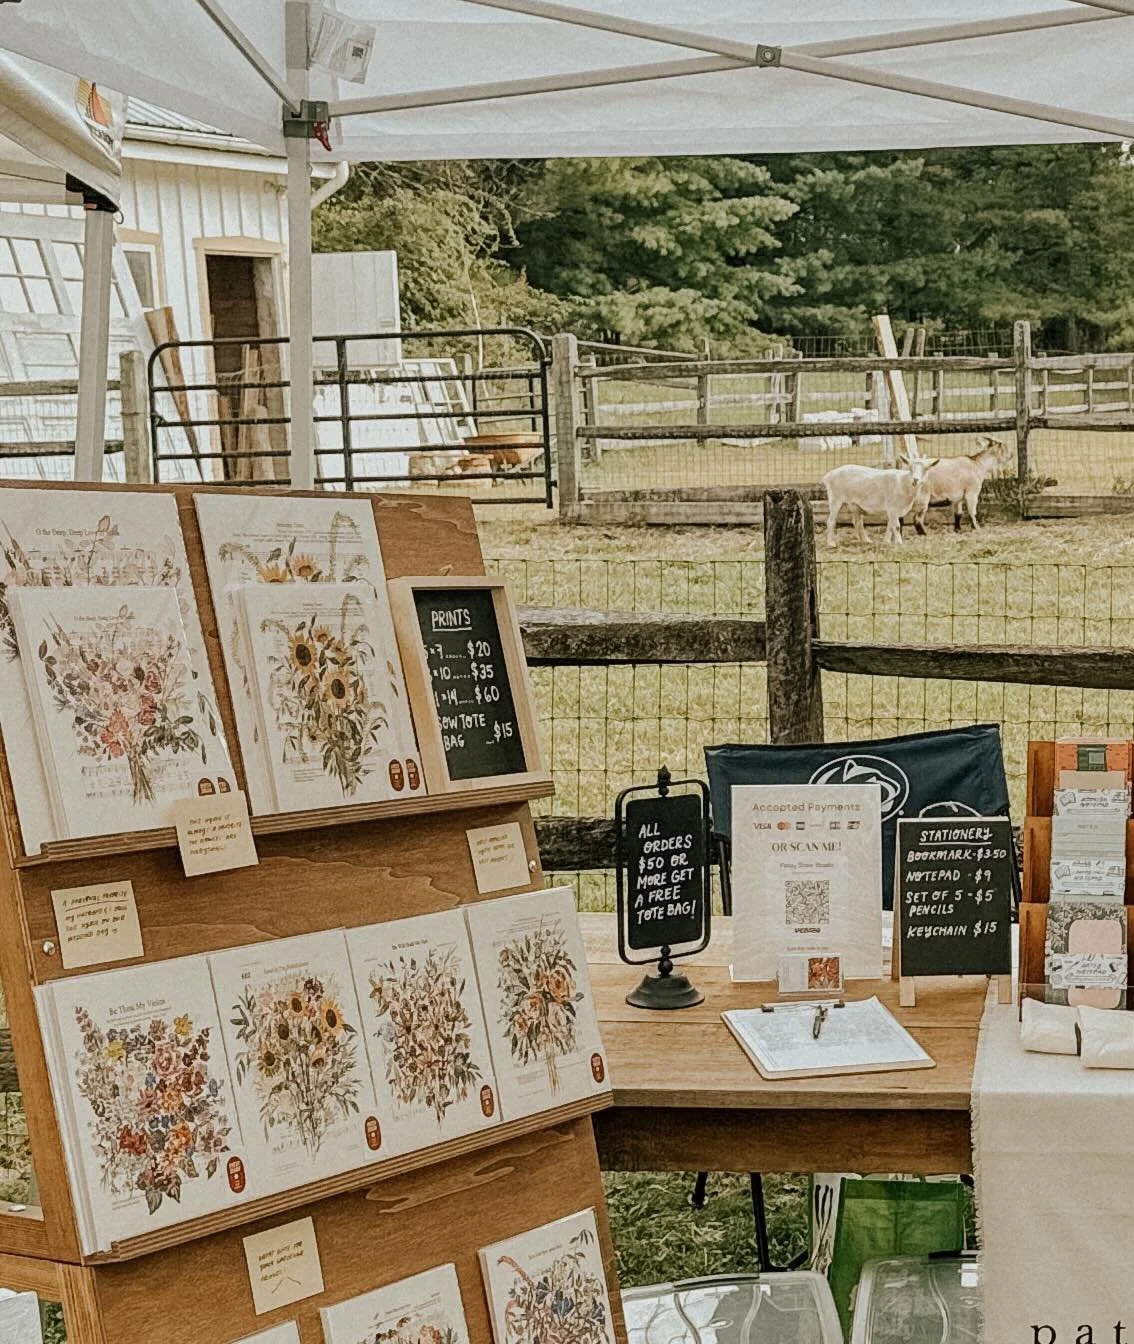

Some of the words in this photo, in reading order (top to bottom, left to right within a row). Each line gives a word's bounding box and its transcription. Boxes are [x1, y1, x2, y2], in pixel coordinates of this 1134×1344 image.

[431, 608, 471, 628] PRINTS
[467, 640, 491, 659] $20
[471, 661, 494, 681] $35
[475, 684, 500, 704] $60
[461, 713, 487, 729] TOTE
[444, 734, 465, 752] BAG
[752, 803, 805, 812] Accepted
[808, 802, 861, 813] Payments
[638, 822, 661, 839] ALL
[919, 827, 993, 842] STATIONERY
[643, 834, 693, 854] ORDERS
[771, 842, 788, 852] OR
[790, 842, 819, 852] SCAN
[822, 842, 842, 852] ME!
[638, 856, 665, 874] $50
[670, 853, 689, 867] OR
[906, 849, 972, 863] BOOKMARK
[637, 872, 667, 890] MORE
[671, 867, 695, 883] GET
[905, 869, 961, 883] NOTEPAD
[974, 868, 992, 884] $9
[634, 893, 644, 909] A
[648, 885, 681, 903] FREE
[905, 891, 929, 904] SET
[931, 890, 949, 901] OF
[954, 889, 963, 901] 5
[974, 888, 995, 905] $5
[636, 906, 665, 925] TOTE
[667, 899, 697, 919] BAG!
[909, 904, 954, 917] PENCILS
[906, 925, 968, 938] KEYCHAIN
[973, 920, 998, 937] $15
